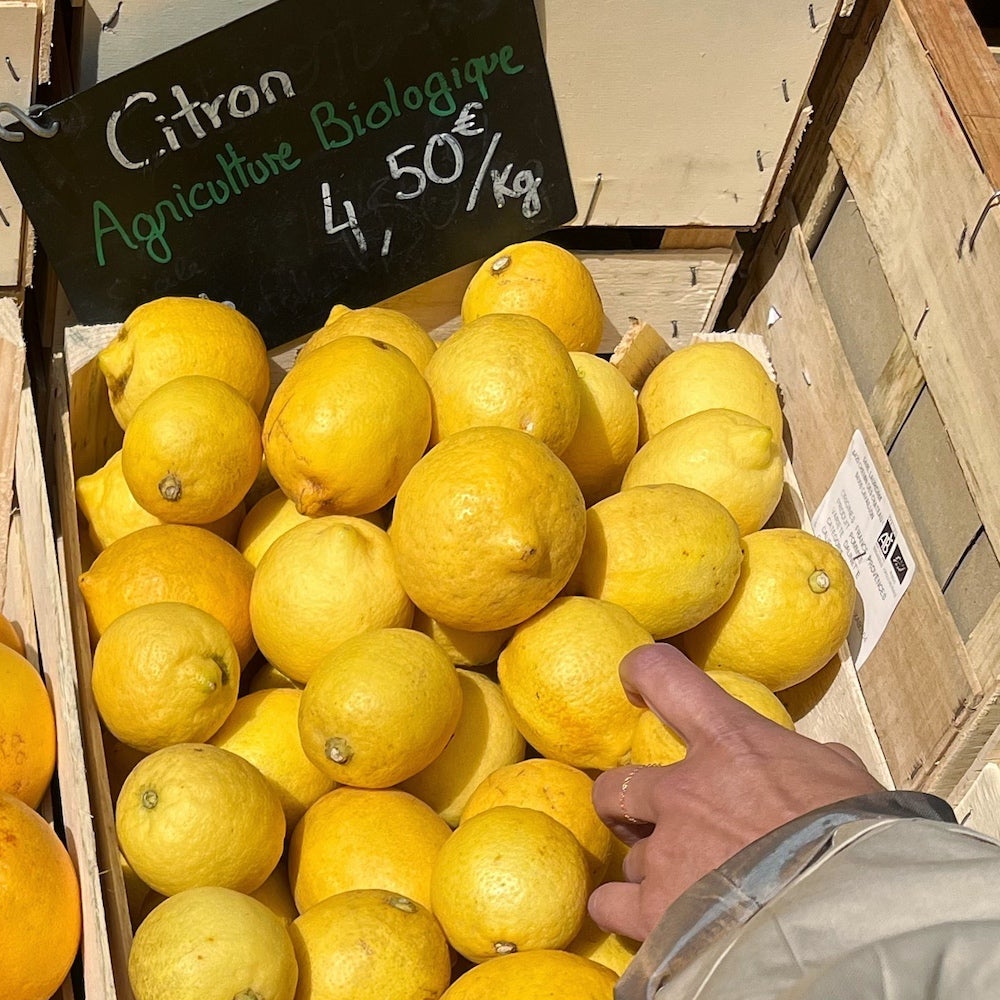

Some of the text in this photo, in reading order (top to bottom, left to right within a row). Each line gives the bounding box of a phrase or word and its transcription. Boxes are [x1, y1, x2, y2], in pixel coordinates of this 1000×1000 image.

[92, 45, 525, 266] Agriculture Biologique
[106, 70, 296, 170] Citron
